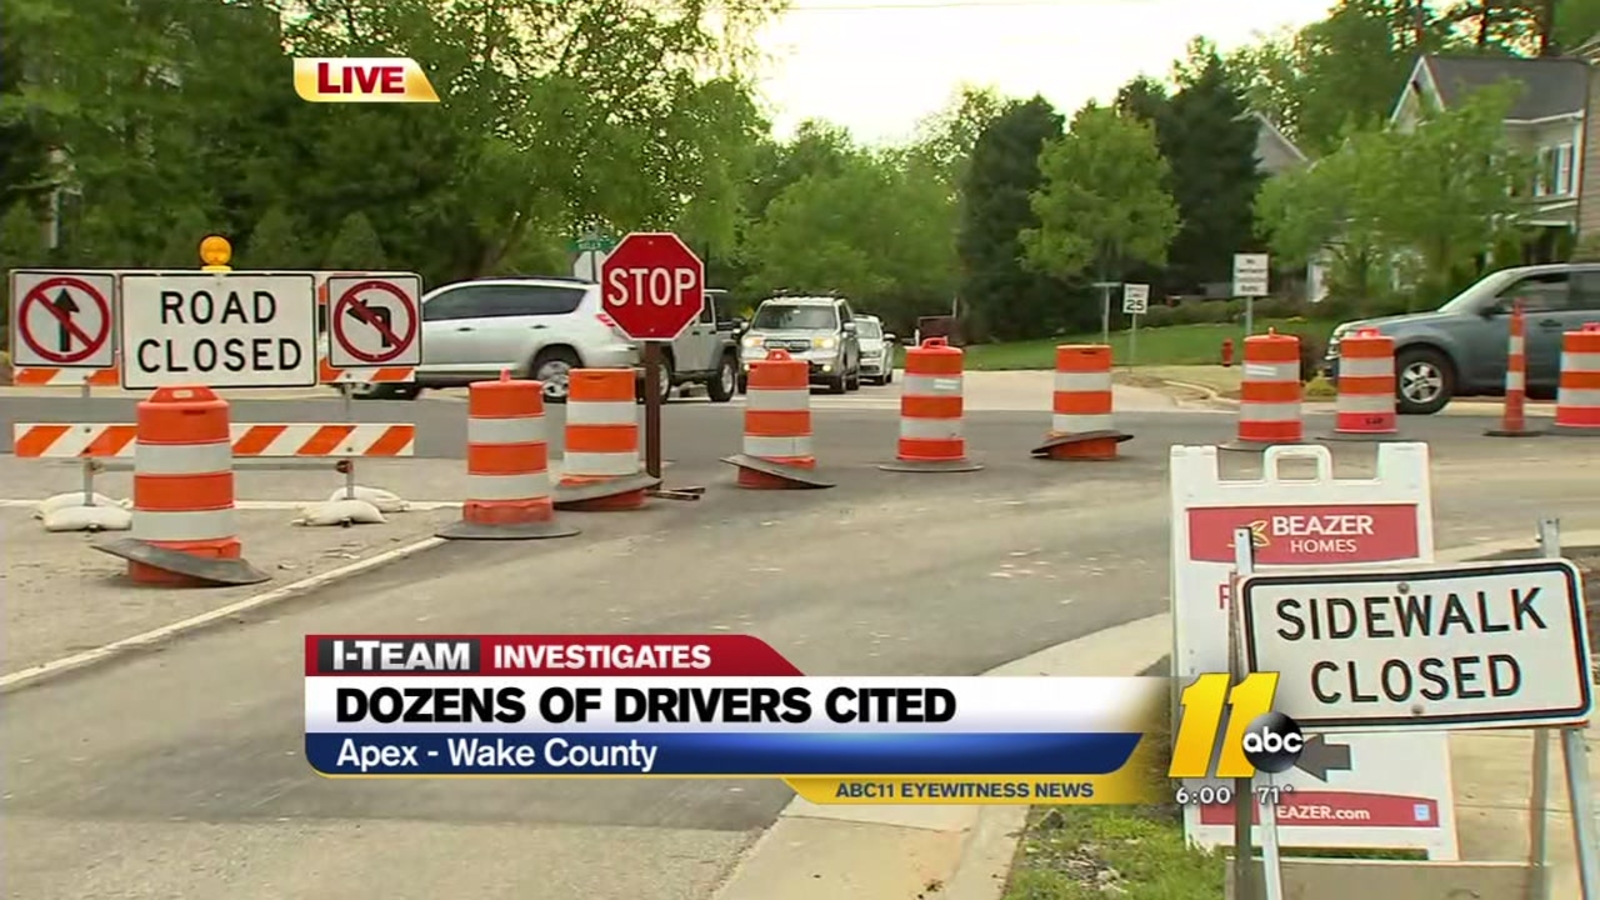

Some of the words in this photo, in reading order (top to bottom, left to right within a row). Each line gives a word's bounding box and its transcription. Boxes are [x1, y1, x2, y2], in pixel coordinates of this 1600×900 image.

[607, 267, 696, 307] STOP
[161, 290, 277, 324] ROAD
[1126, 299, 1145, 311] 25
[137, 337, 302, 373] CLOSED
[1273, 515, 1374, 536] BEAZER
[1291, 539, 1358, 554] HOMES
[1276, 587, 1548, 642] SIDEWALK
[1311, 654, 1521, 705] CLOSED
[1276, 804, 1371, 821] EAZER.com
